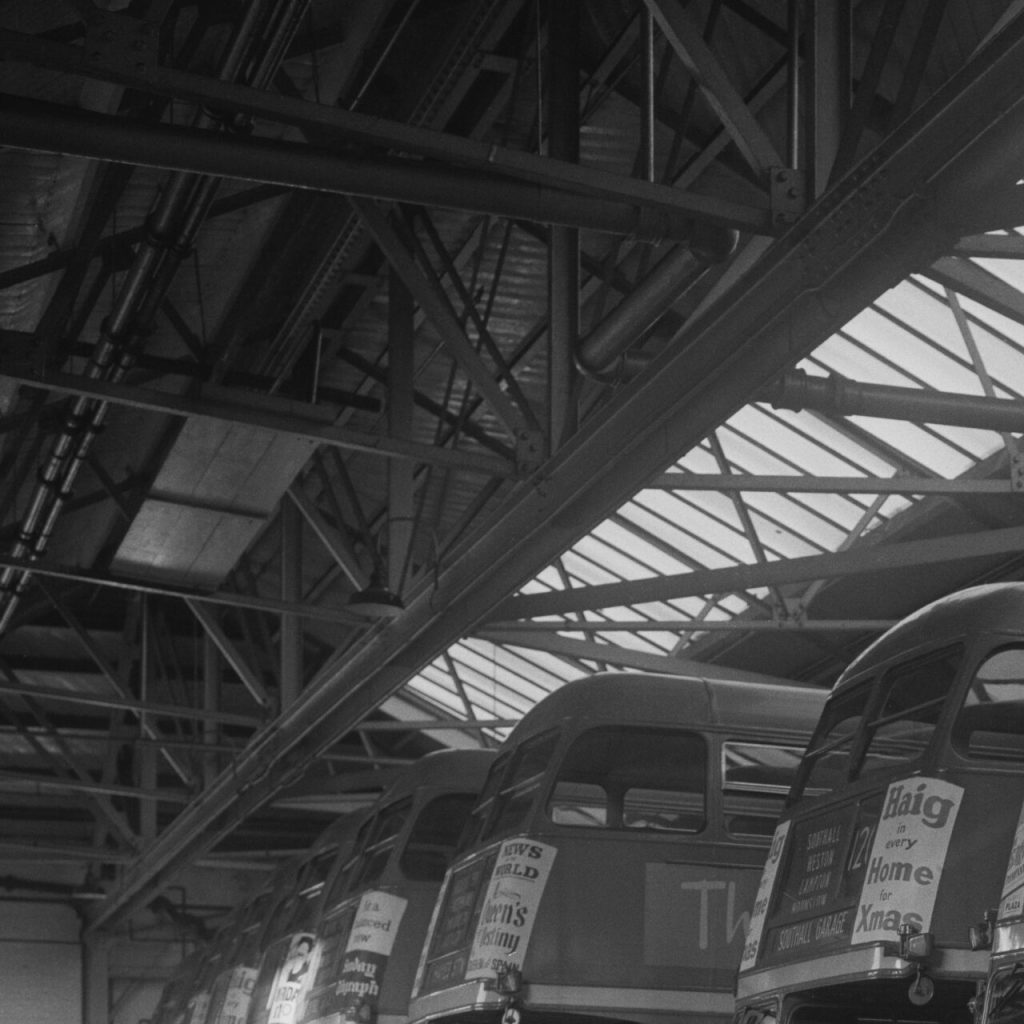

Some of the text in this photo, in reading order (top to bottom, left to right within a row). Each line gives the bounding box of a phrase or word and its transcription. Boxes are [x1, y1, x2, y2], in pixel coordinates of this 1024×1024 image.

[883, 783, 956, 829] Haig
[896, 822, 906, 834] in
[885, 837, 918, 851] every
[867, 856, 935, 886] Home
[879, 888, 893, 902] for
[1005, 900, 1021, 911] PLAZA
[855, 903, 924, 934] Xmas
